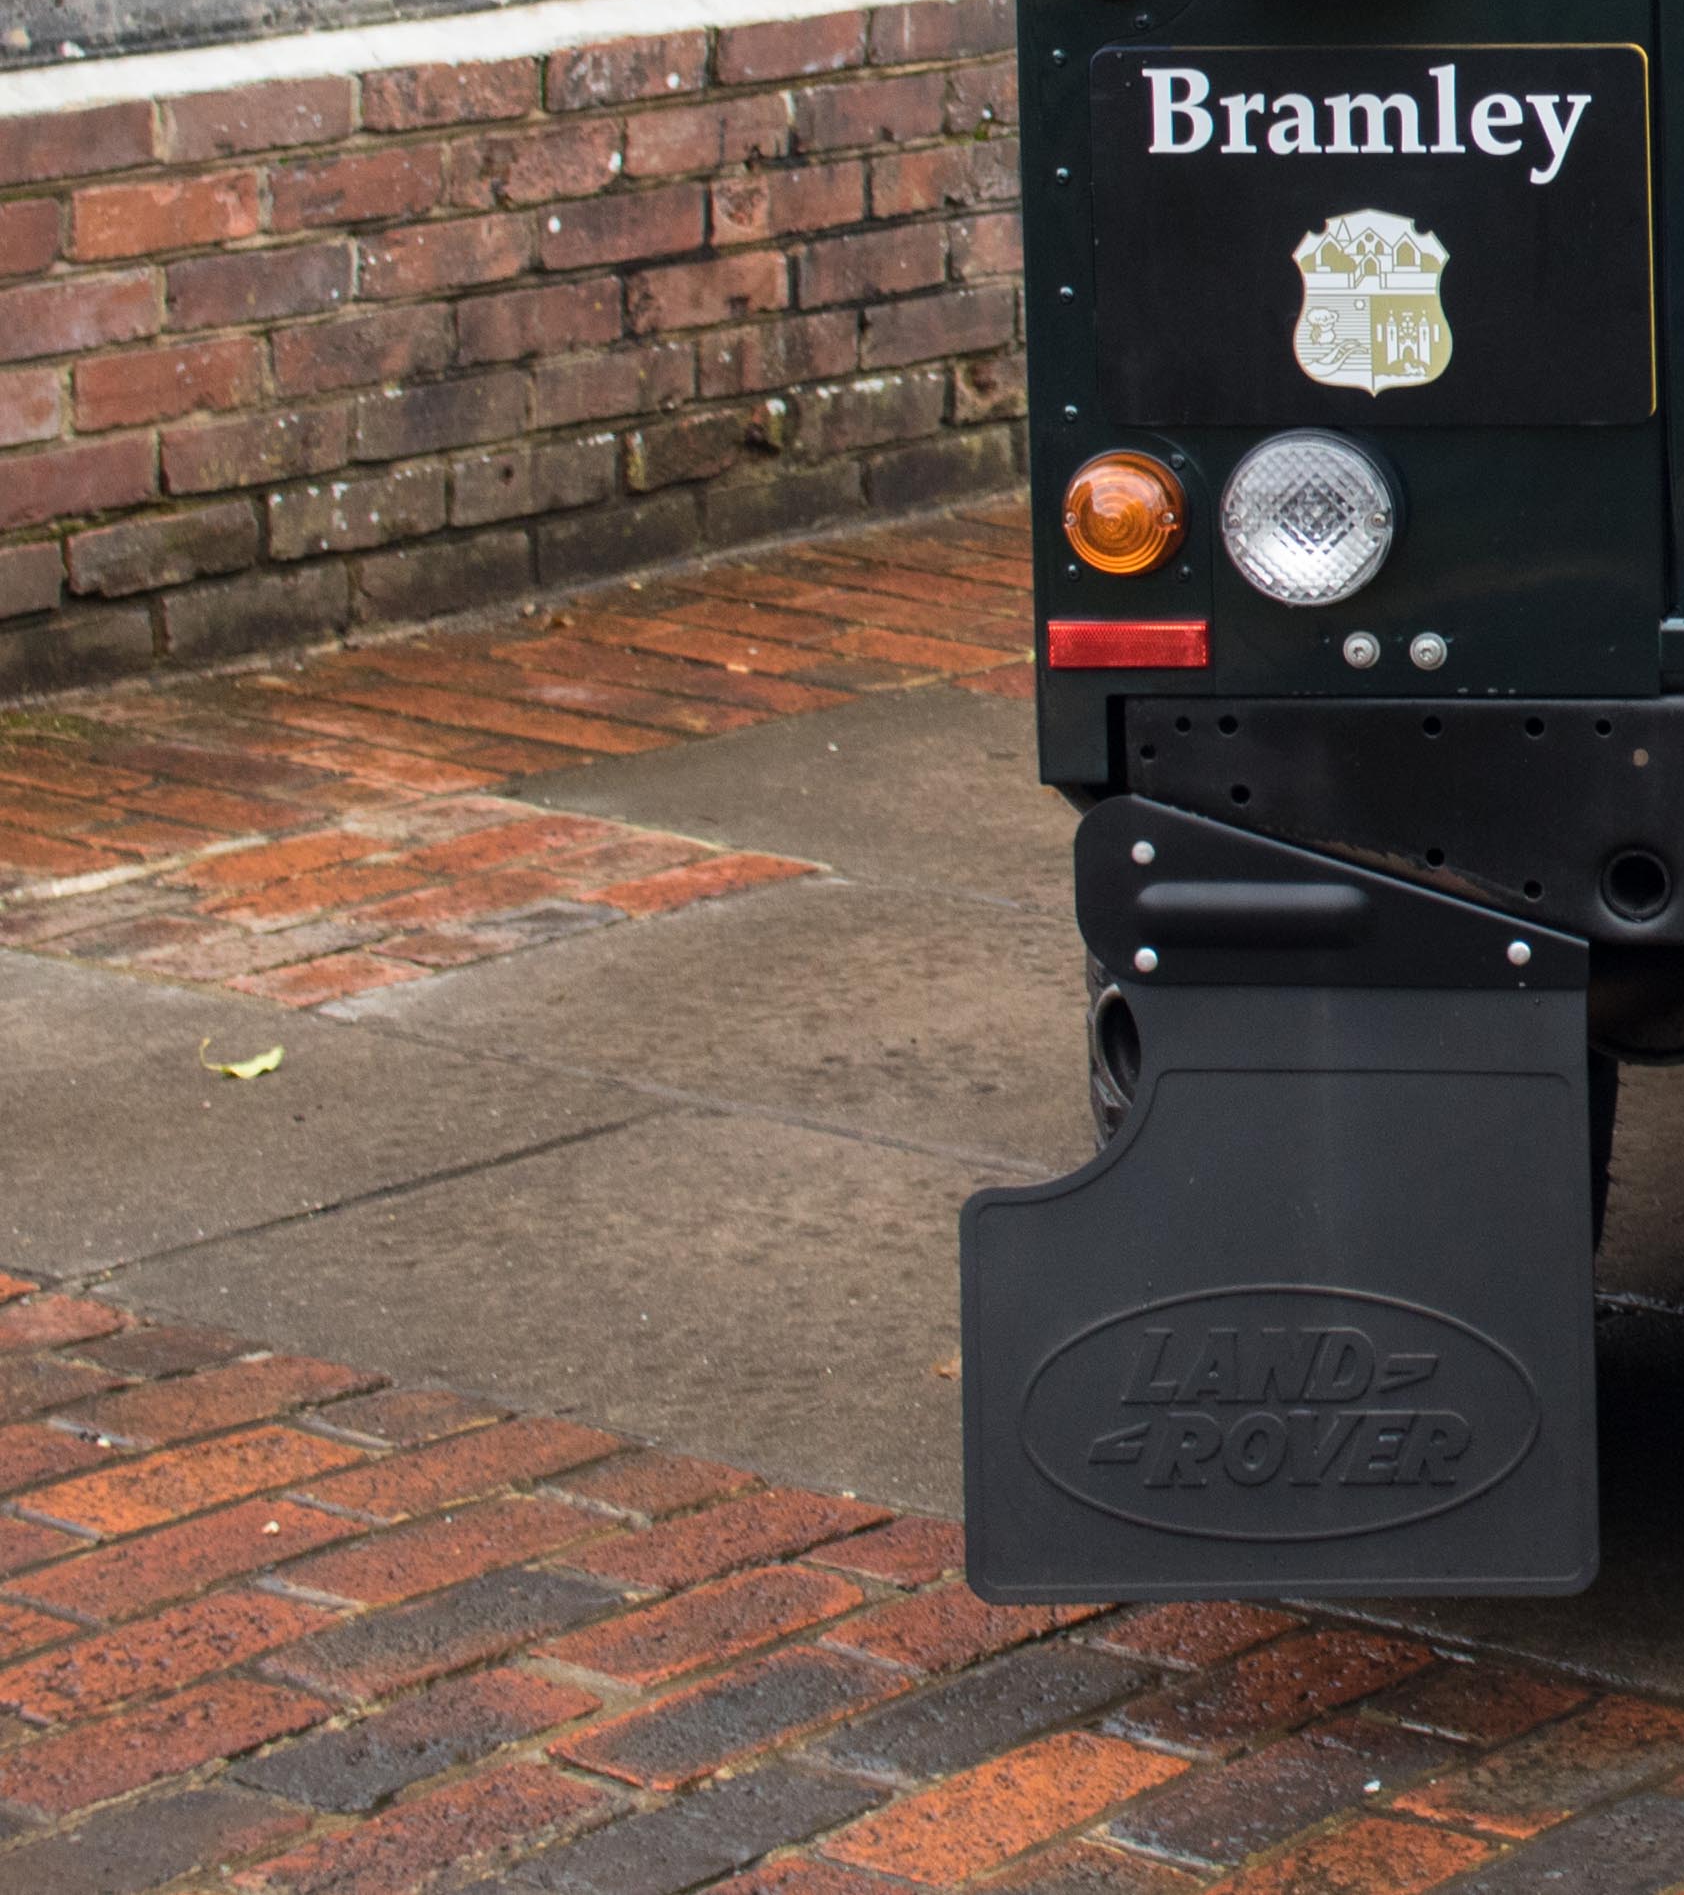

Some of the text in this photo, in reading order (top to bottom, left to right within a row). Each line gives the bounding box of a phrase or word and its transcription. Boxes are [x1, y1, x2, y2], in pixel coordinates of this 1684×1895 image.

[1142, 64, 1592, 184] Bramley
[1119, 1328, 1377, 1405] LAND
[1143, 1412, 1472, 1488] ROVER
